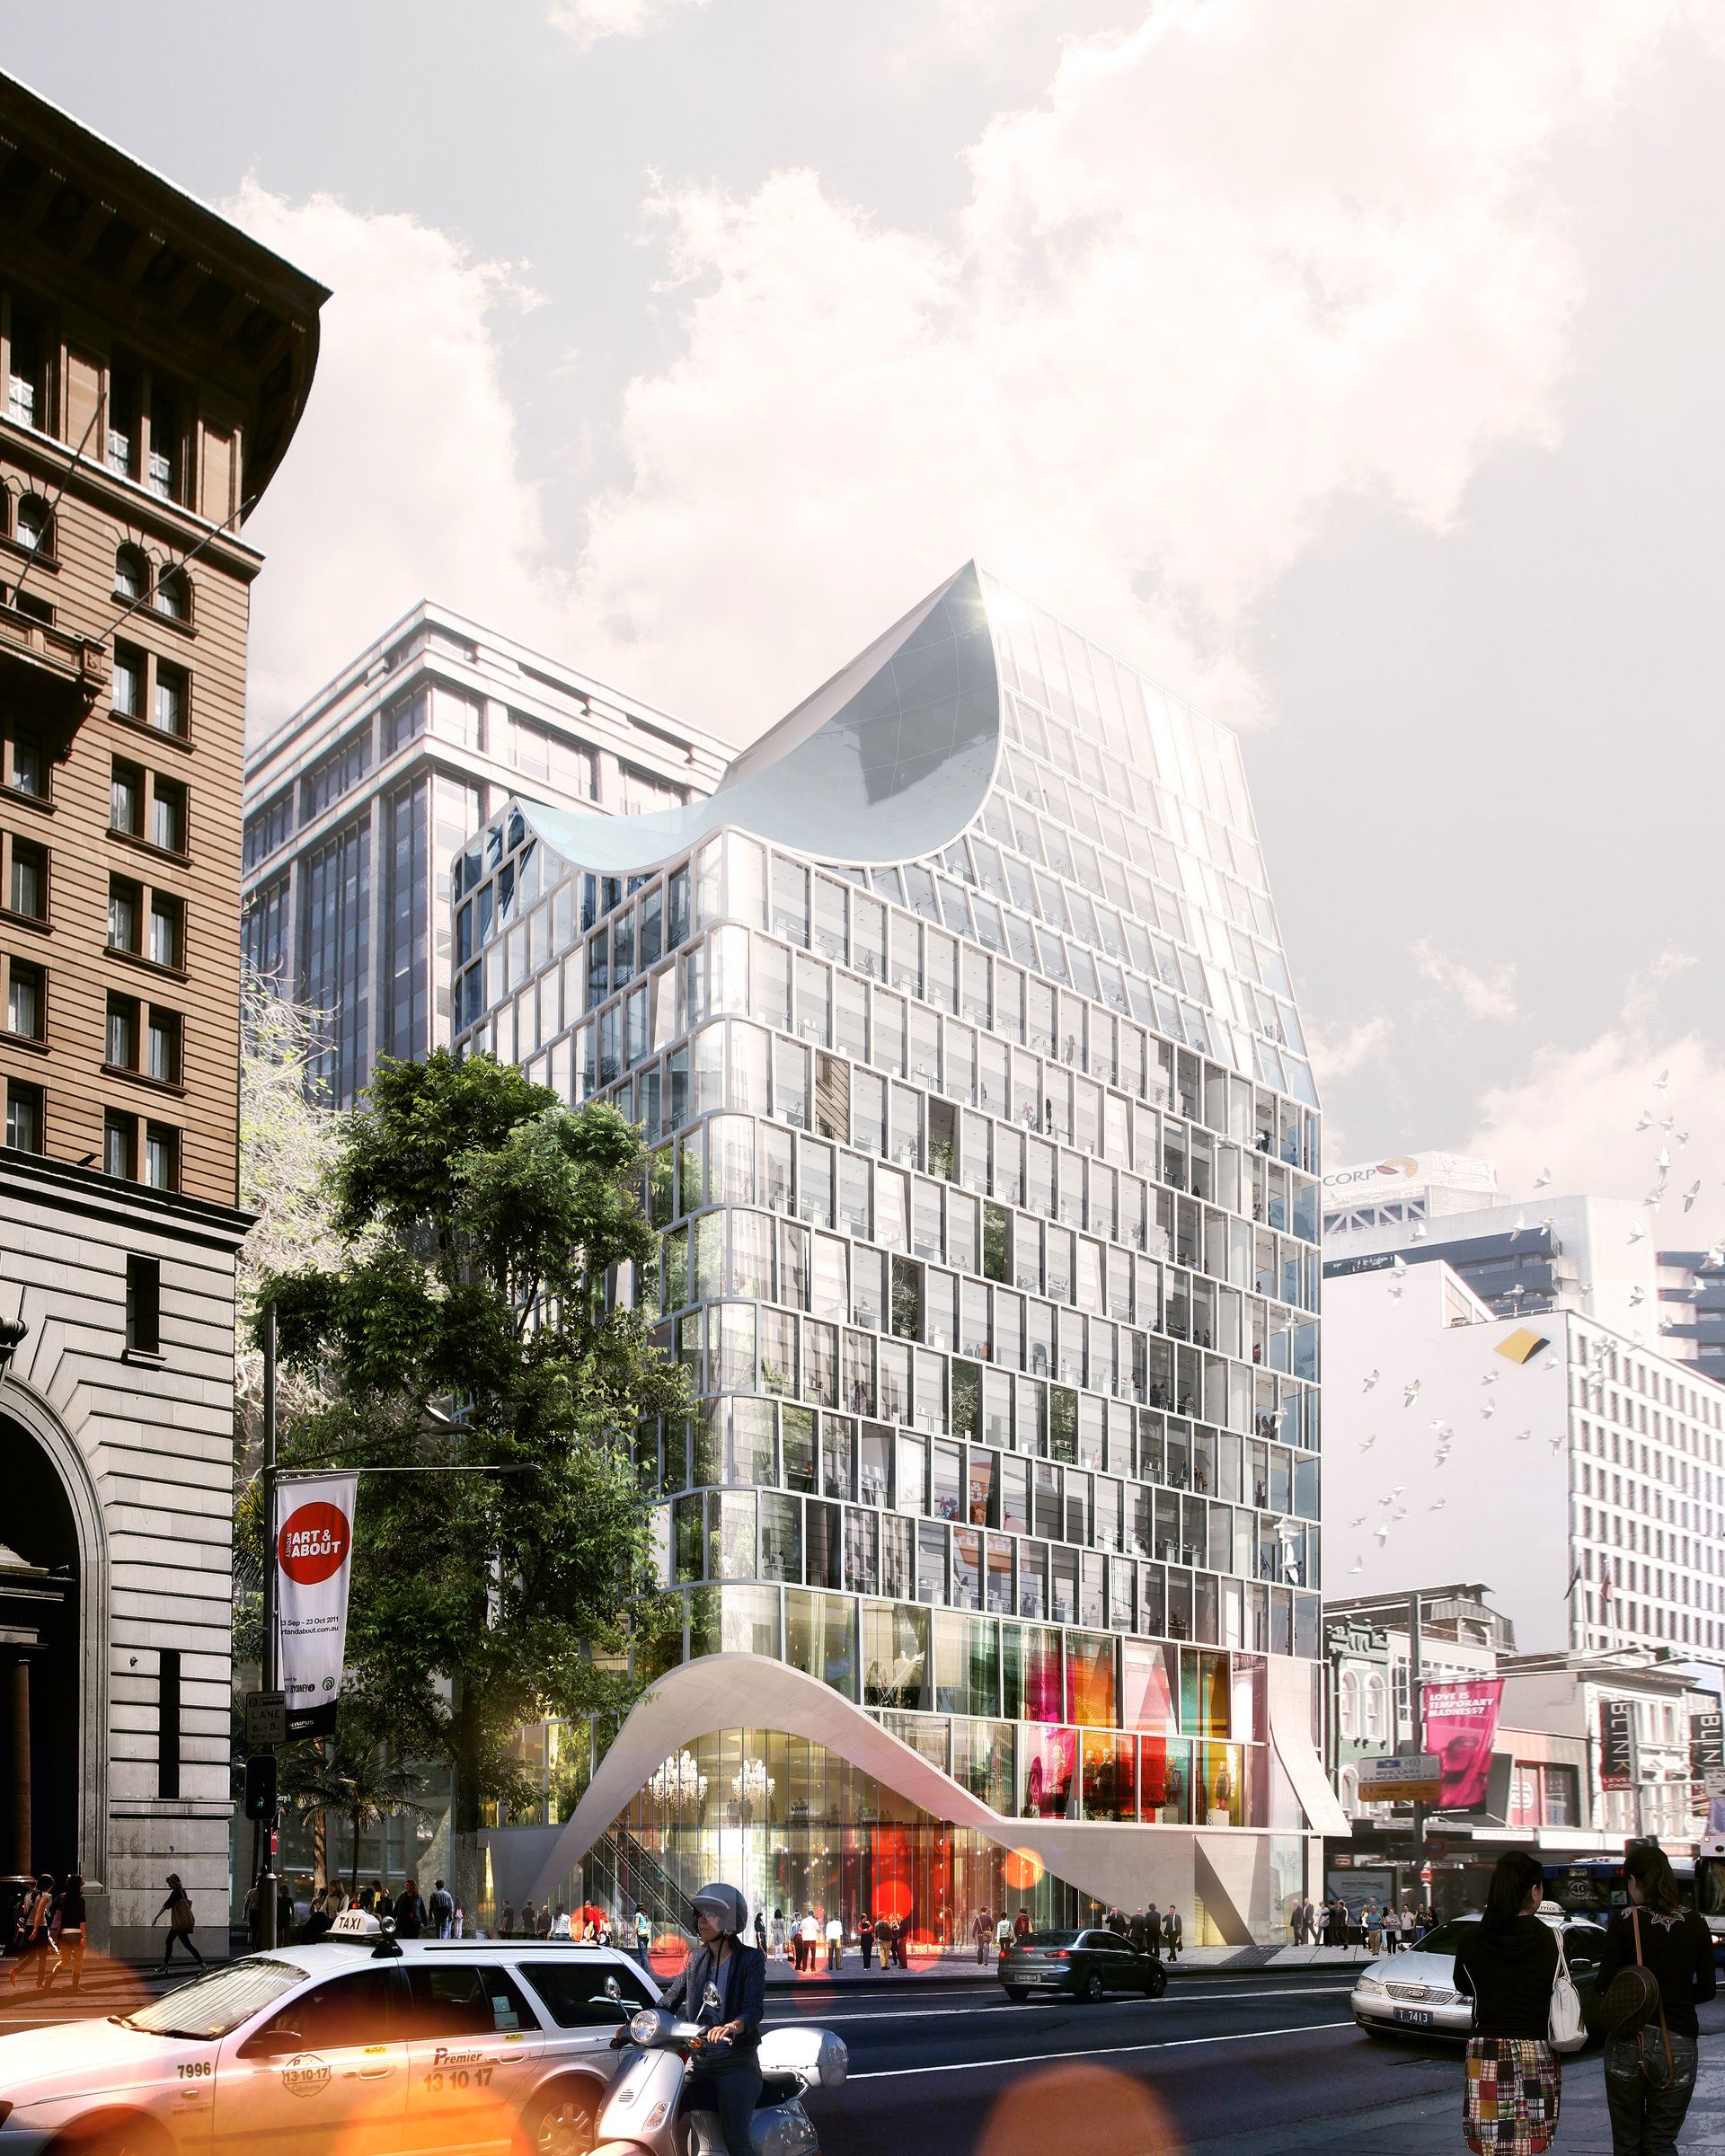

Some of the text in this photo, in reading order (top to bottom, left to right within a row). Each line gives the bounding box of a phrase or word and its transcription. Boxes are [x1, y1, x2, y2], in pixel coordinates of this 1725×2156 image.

[292, 1529, 332, 1545] ART &
[291, 1541, 341, 1558] ABOUT
[288, 1619, 300, 1627] Sep
[281, 1626, 339, 1635] rtandabout.com.au
[1429, 1691, 1471, 1701] LOVE IS
[1429, 1698, 1494, 1709] TEMPORARY
[252, 1709, 281, 1719] LANE
[1700, 1714, 1721, 1763] BLIN
[1571, 1884, 1586, 1893] 40
[339, 1916, 361, 1930] TAXI
[1399, 2010, 1404, 2019] T
[1408, 2011, 1428, 2022] 7413
[434, 2047, 482, 2065] Premier
[177, 2062, 211, 2080] 7996
[423, 2067, 493, 2092] 13 10 17
